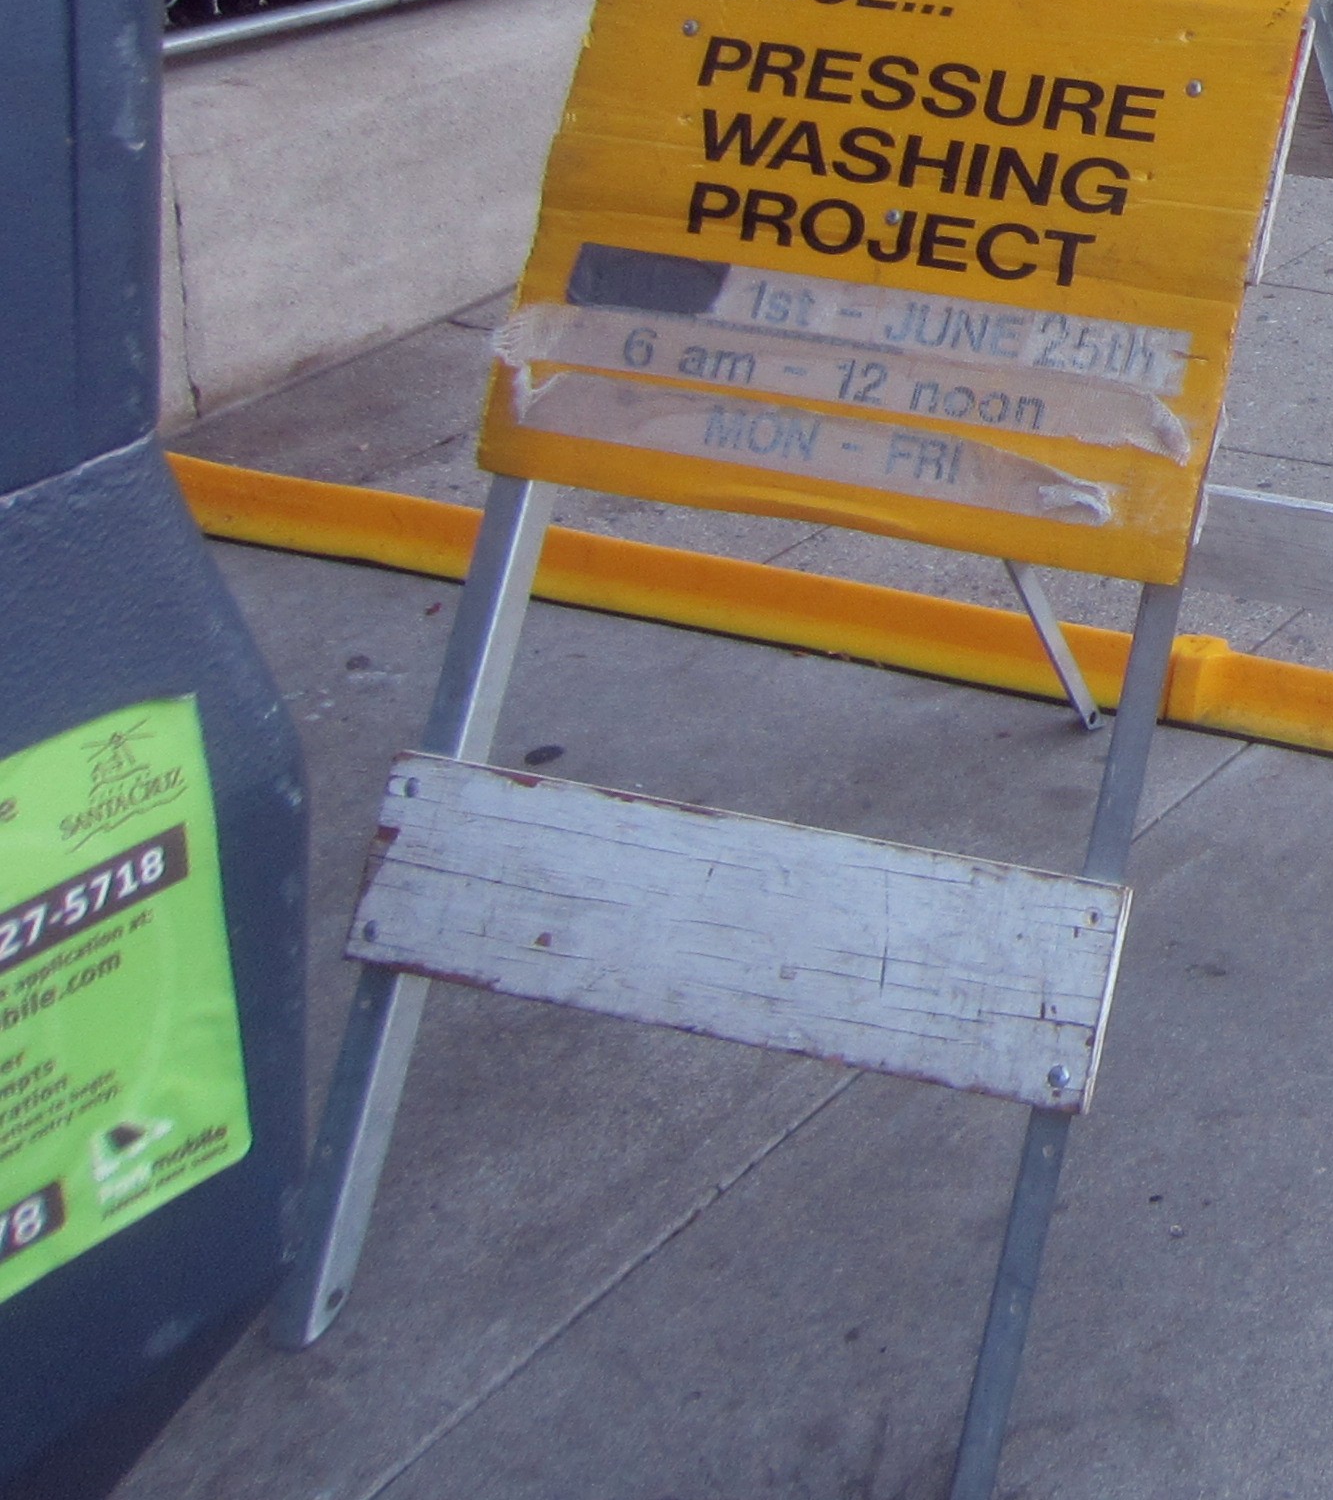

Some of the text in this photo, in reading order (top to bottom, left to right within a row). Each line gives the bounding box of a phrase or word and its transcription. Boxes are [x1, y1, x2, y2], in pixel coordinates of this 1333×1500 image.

[697, 36, 1167, 144] PRESSURE
[700, 108, 1132, 217] WASHING
[686, 182, 1097, 288] PROJECT
[622, 328, 655, 368] 6
[678, 342, 756, 385] am
[834, 357, 888, 411] 12
[907, 373, 1048, 433] noon
[882, 300, 1027, 364] JUNE
[1033, 311, 1157, 376] 25th
[702, 405, 819, 462] MON
[885, 433, 960, 487] FRI
[0, 846, 166, 961] 27-5718
